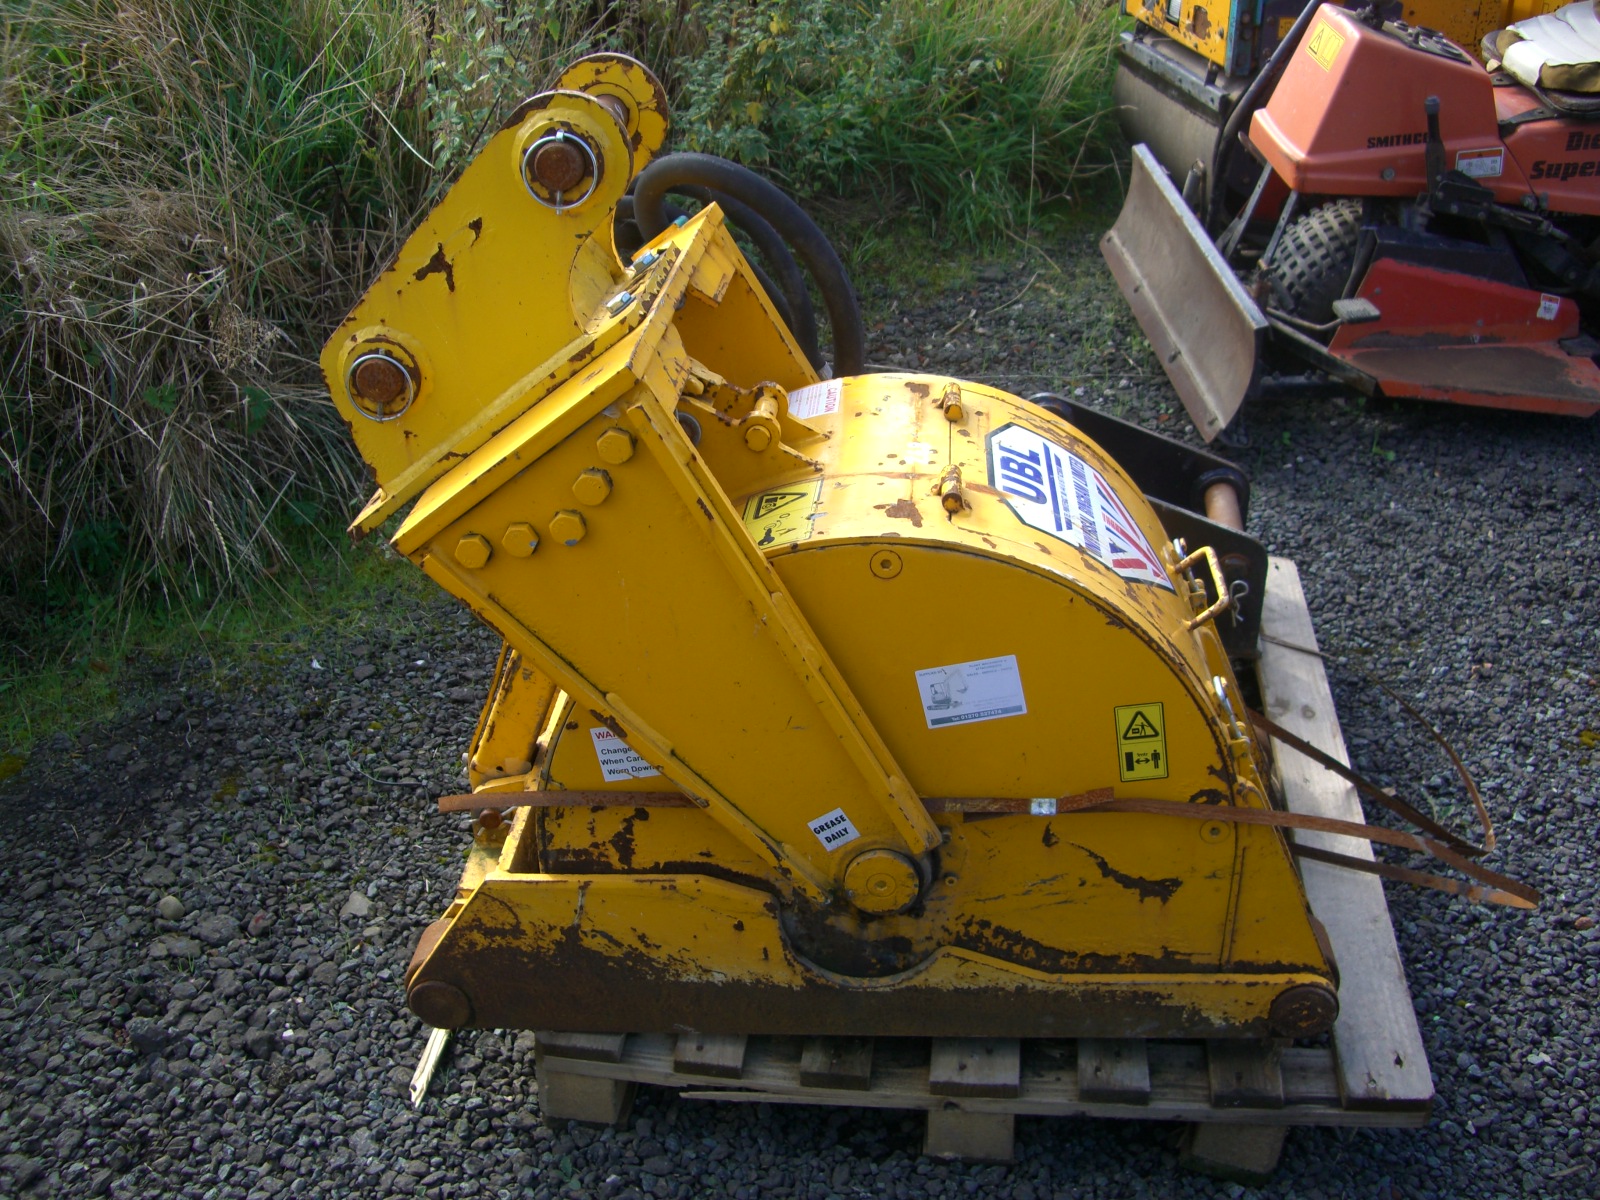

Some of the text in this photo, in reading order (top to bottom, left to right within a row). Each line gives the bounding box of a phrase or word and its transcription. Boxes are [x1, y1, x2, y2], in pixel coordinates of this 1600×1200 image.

[998, 441, 1047, 504] UBL
[601, 757, 624, 766] When
[608, 767, 630, 775] Worn
[813, 815, 847, 835] GREASE
[824, 827, 849, 844] DAILY
